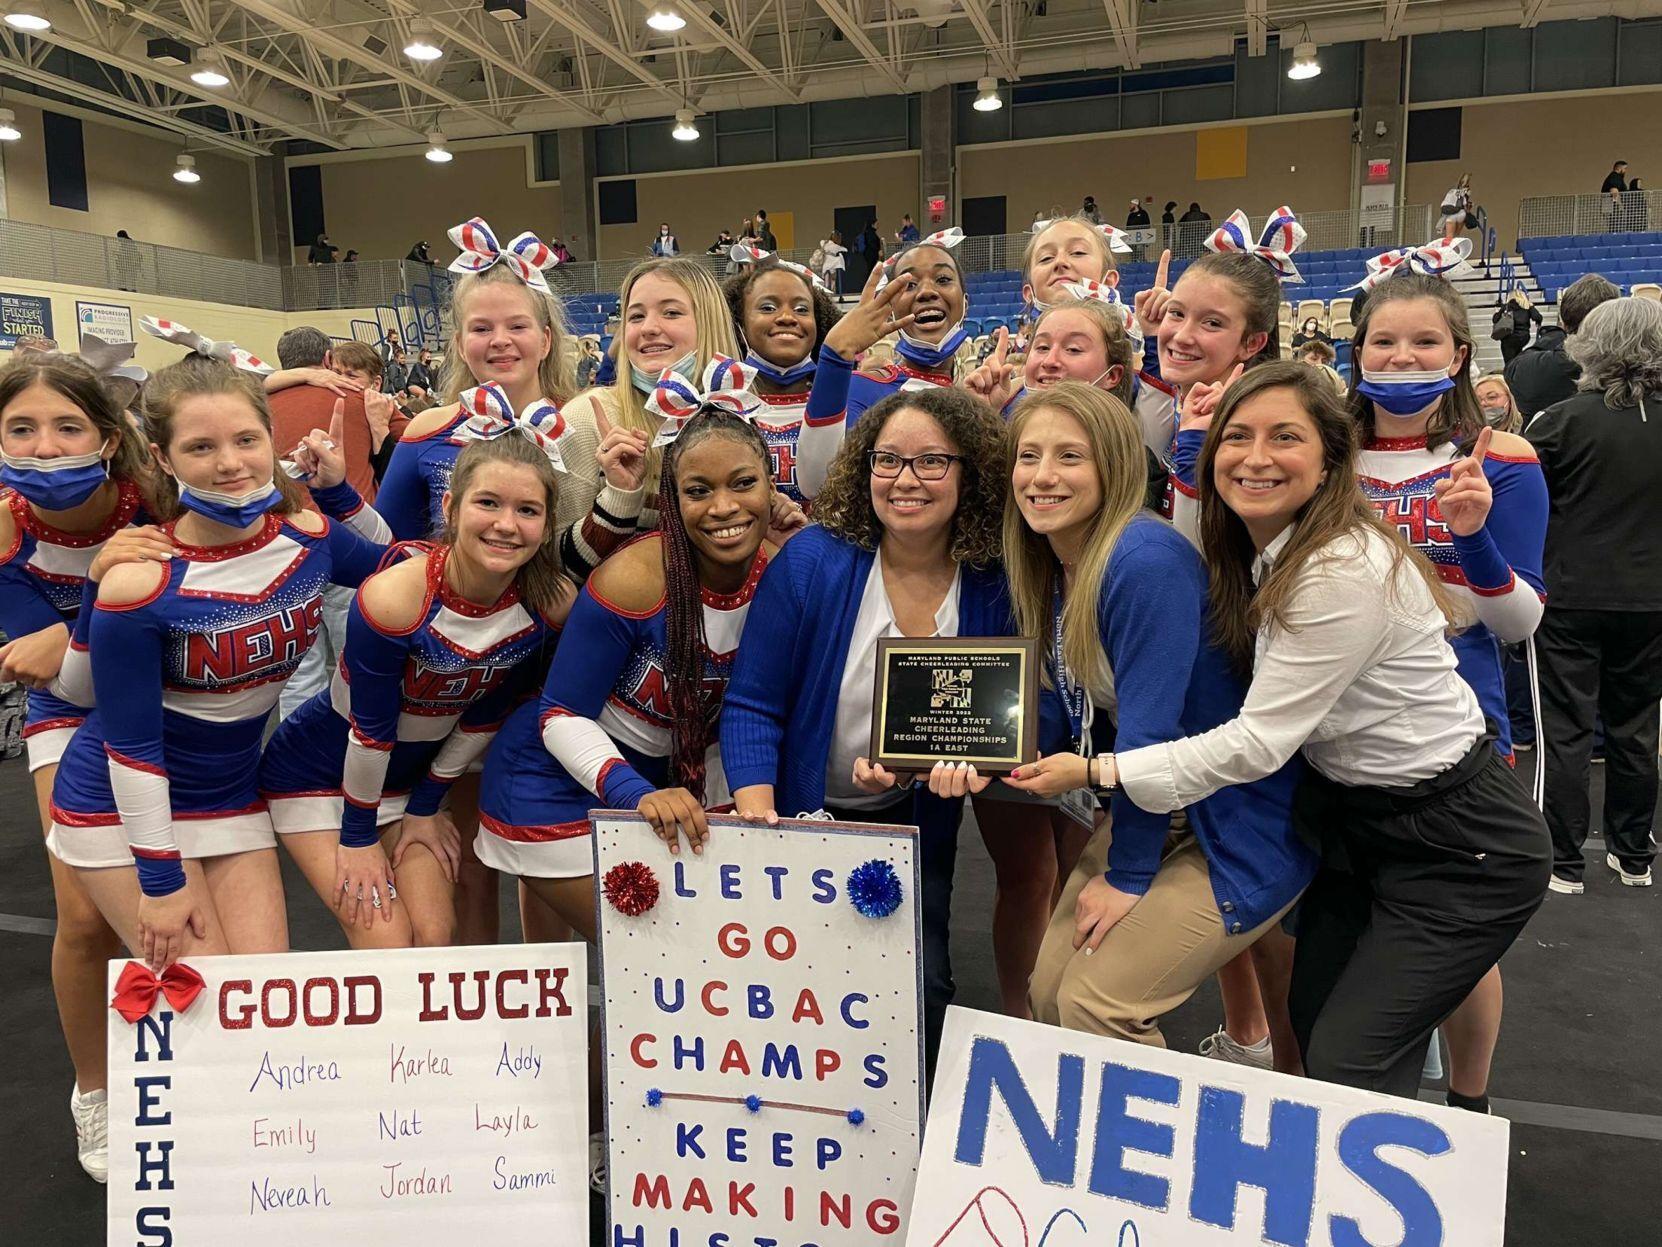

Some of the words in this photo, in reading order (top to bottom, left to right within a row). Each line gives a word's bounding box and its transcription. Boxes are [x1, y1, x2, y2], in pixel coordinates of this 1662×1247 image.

[2, 307, 44, 324] FINISH
[3, 322, 45, 336] STARTED
[94, 309, 129, 317] PROGRESSIVE
[1058, 665, 1066, 688] High
[909, 716, 958, 724] MARYLAND
[962, 717, 992, 725] STATE
[1074, 689, 1082, 717] North
[893, 733, 928, 741] REGION
[931, 735, 1008, 744] CHAMPIONSHIPS
[914, 725, 986, 734] CHEERLEADING
[945, 744, 969, 752] EAST
[674, 861, 837, 904] LETS
[717, 922, 798, 961] GO
[218, 975, 382, 1030] GOOD
[418, 968, 572, 1023] LUCK
[654, 977, 870, 1029] UCBAC
[250, 1051, 342, 1092] Andrea
[389, 1043, 453, 1083] Karlea
[496, 1043, 542, 1079] Addy
[630, 1033, 888, 1089] CHAMPS
[134, 1011, 175, 1247] NEHS
[253, 1119, 316, 1154] Emily
[379, 1110, 424, 1140] Nat
[475, 1103, 539, 1137] Layla
[676, 1122, 842, 1170] KEEP
[953, 1033, 1455, 1247] NEHS
[380, 1162, 453, 1199] Jordan
[493, 1155, 557, 1191] Sammi
[632, 1172, 901, 1235] MAKING
